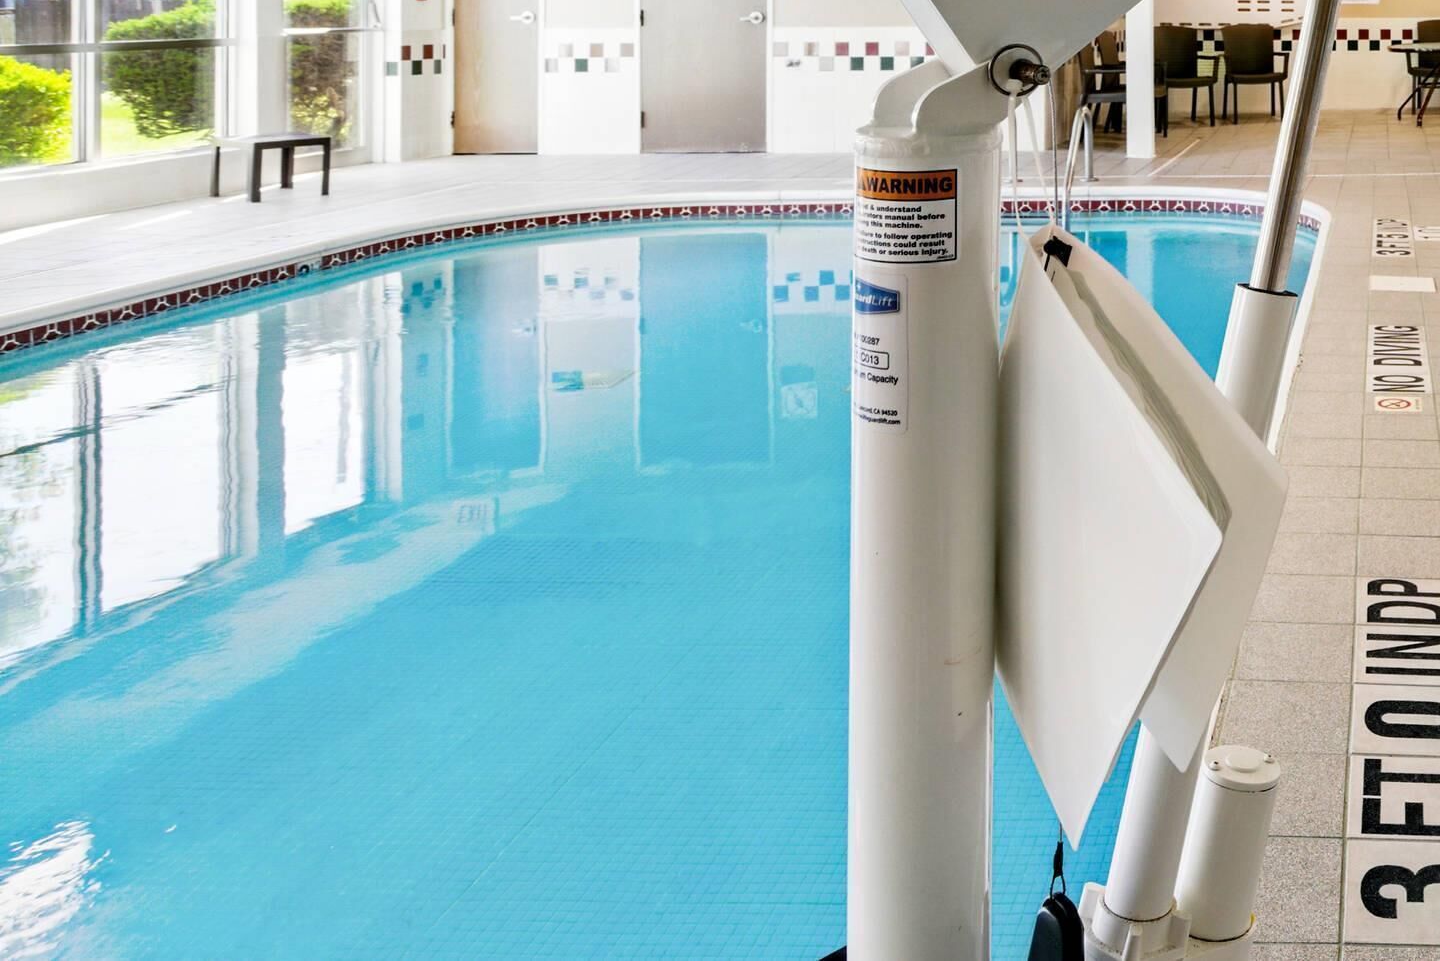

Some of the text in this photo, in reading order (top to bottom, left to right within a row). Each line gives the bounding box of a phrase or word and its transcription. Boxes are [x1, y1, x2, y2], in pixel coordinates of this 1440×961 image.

[866, 176, 953, 194] WARNING
[884, 232, 908, 240] follow
[910, 231, 953, 241] operating
[893, 240, 917, 248] could
[919, 239, 945, 247] result
[921, 248, 948, 256] injury.
[861, 352, 880, 366] C013
[1372, 325, 1426, 393] NO DIVING
[867, 372, 899, 386] Capacity
